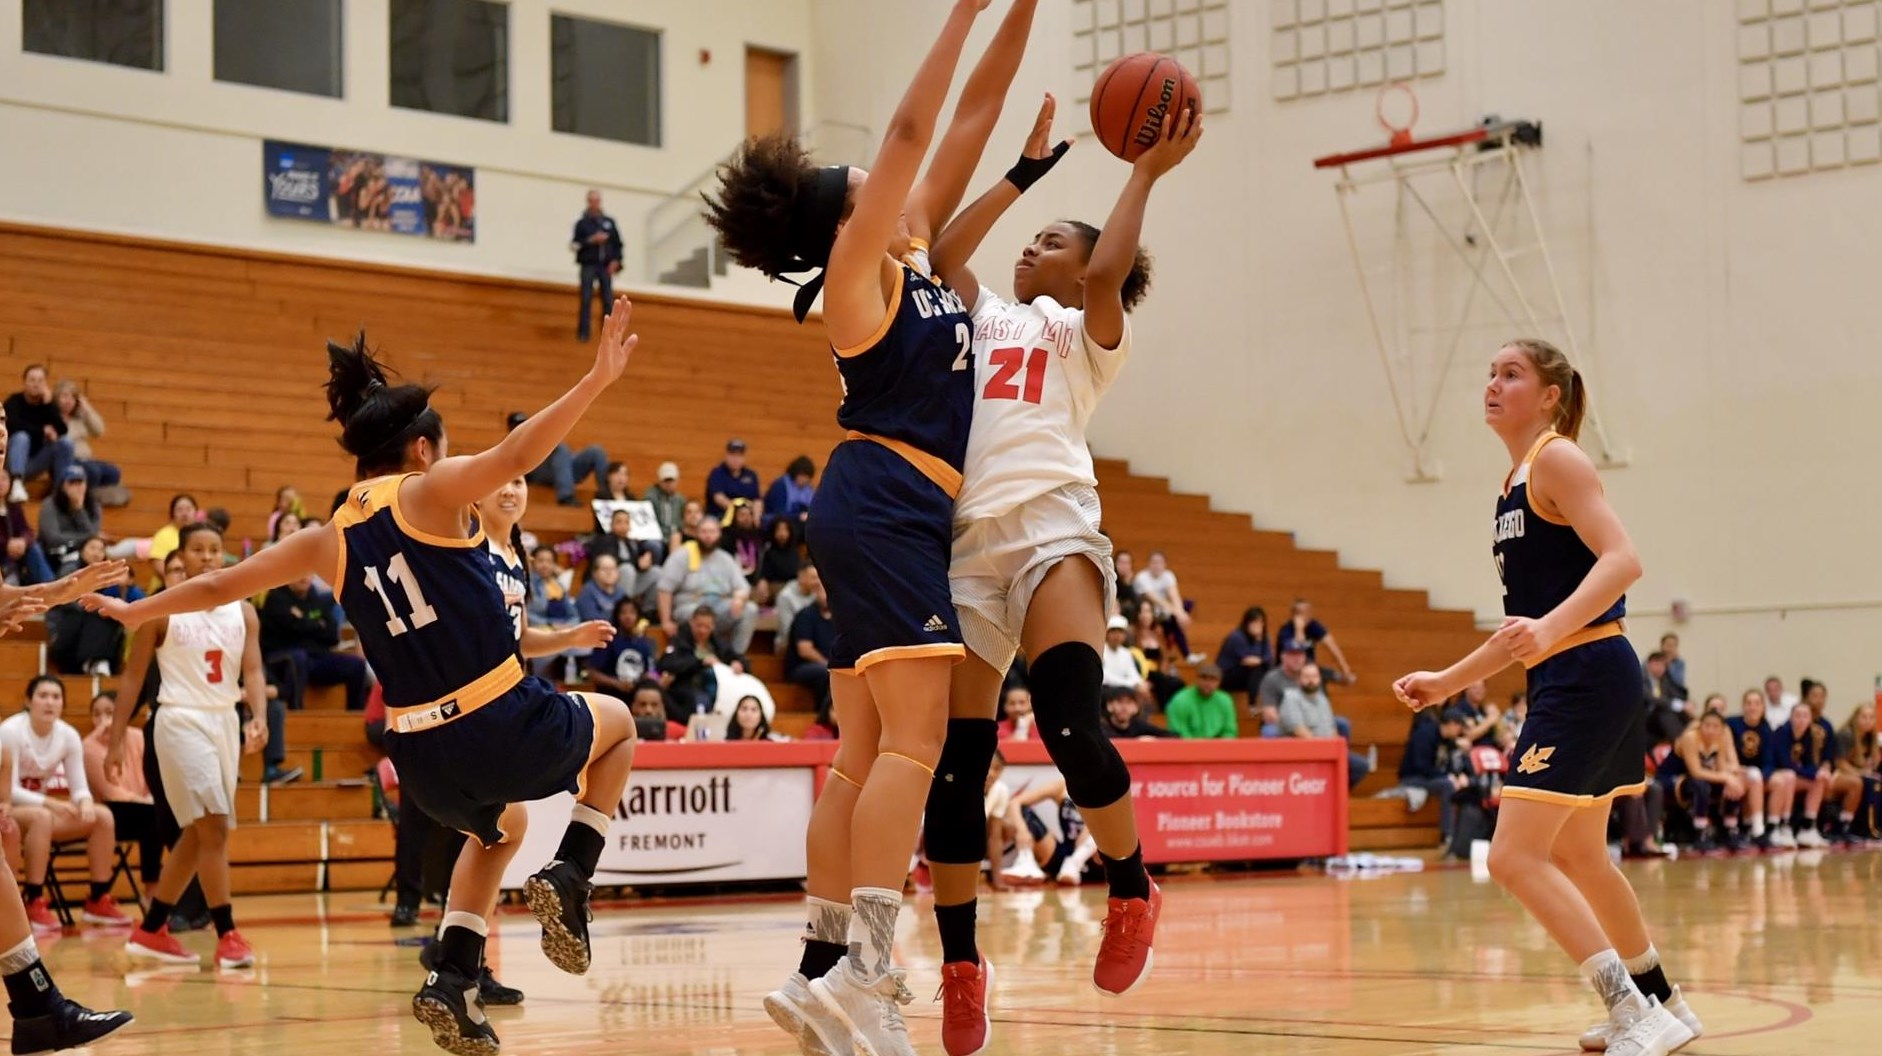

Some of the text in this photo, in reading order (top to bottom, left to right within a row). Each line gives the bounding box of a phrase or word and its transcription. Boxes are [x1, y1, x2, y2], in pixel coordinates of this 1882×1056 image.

[1134, 79, 1175, 147] Wilson
[974, 316, 1027, 341] AST
[952, 322, 975, 372] 2
[982, 347, 1048, 405] 21
[363, 551, 438, 637] 11
[205, 650, 223, 684] 3
[1147, 782, 1199, 799] source
[1202, 771, 1225, 797] for
[1228, 773, 1285, 797] Pioneer
[1288, 772, 1327, 796] Gear
[1157, 811, 1282, 832] Pioneer Bookstore
[620, 833, 706, 851] FREMONT
